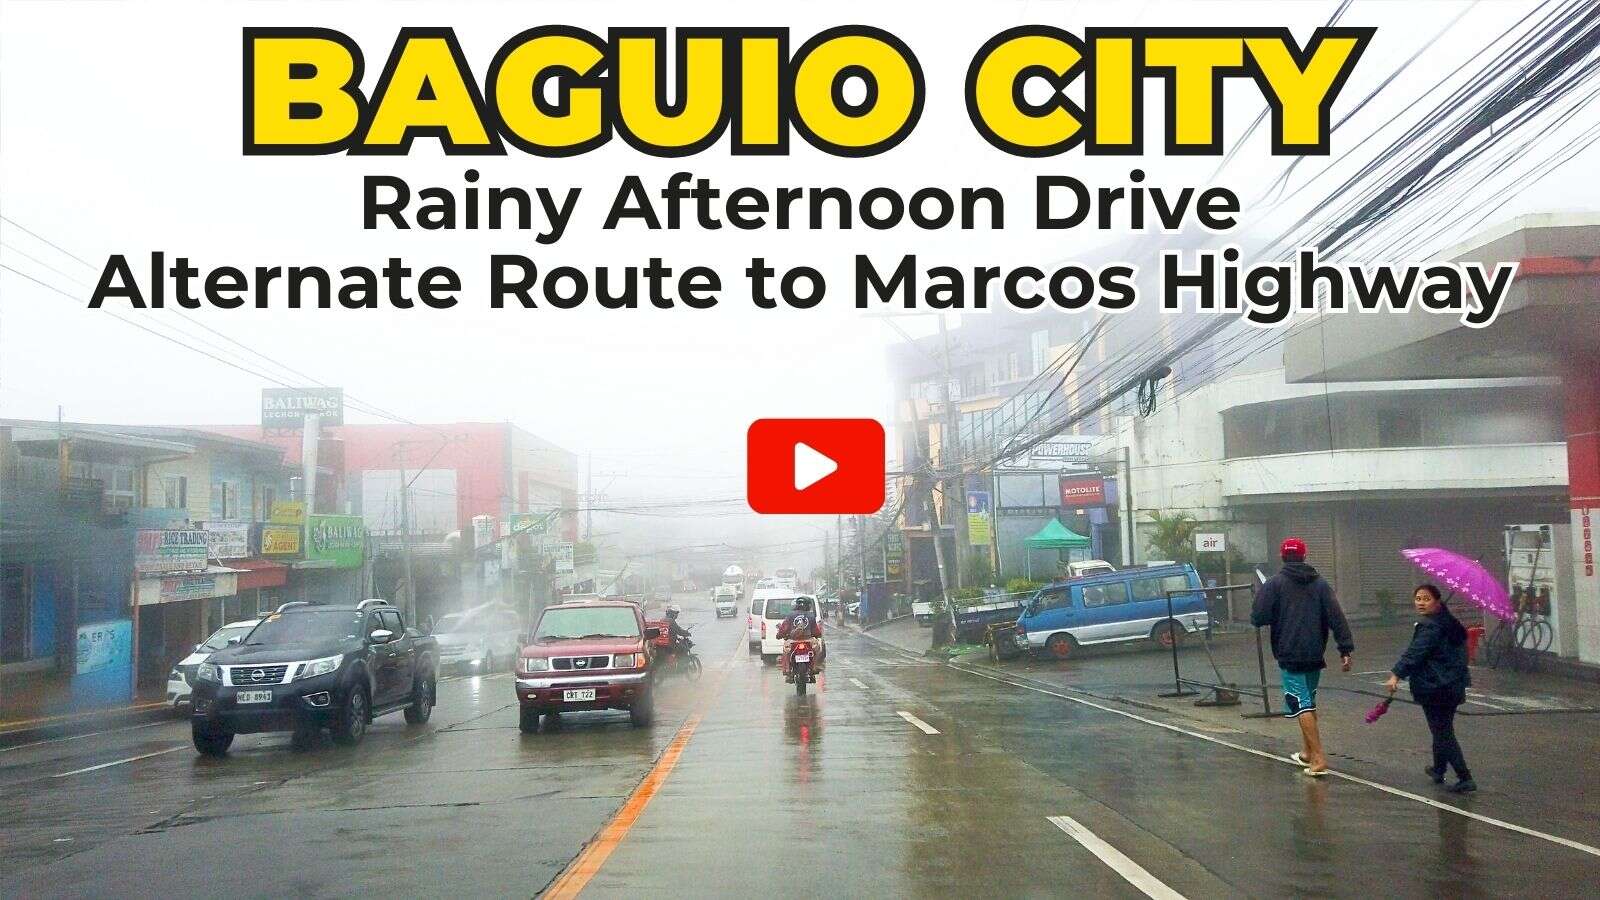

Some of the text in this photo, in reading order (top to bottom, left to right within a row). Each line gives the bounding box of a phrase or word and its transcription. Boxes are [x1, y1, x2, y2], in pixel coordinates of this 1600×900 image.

[263, 397, 338, 410] BALIWAG
[1064, 486, 1100, 495] MOTOLITE
[164, 531, 179, 545] RICE
[180, 531, 207, 545] TRADING
[1203, 537, 1218, 548] air
